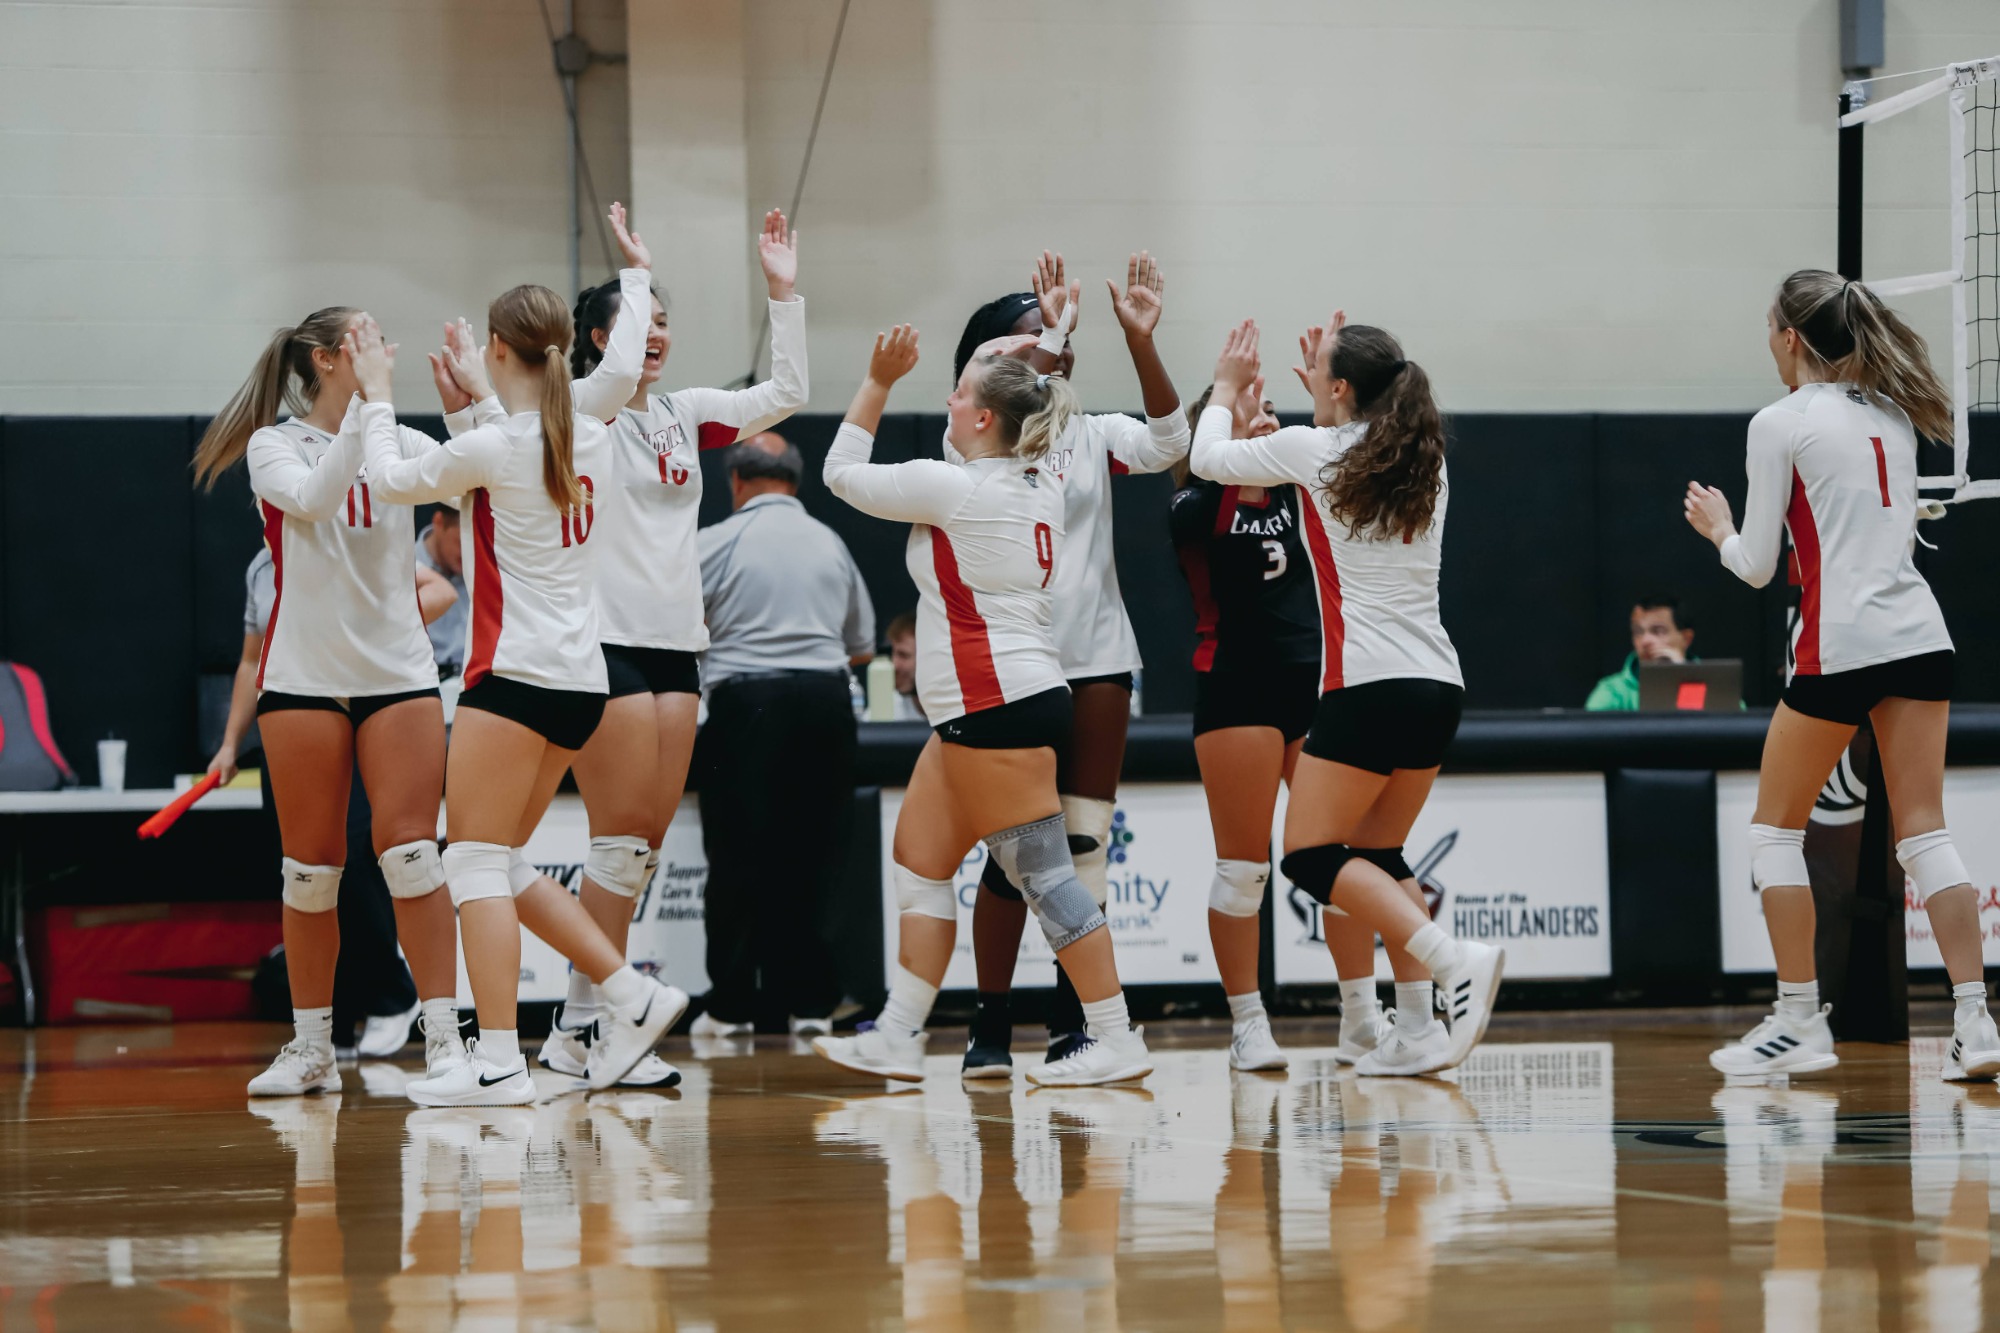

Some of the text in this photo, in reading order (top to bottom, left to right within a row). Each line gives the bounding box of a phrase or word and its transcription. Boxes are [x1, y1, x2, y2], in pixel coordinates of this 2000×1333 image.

[1868, 437, 1892, 507] 1
[347, 483, 373, 529] 11
[1034, 522, 1053, 589] 9
[1262, 540, 1287, 580] 3
[1455, 894, 1487, 904] Home
[1454, 906, 1599, 938] HIGHLANDERS
